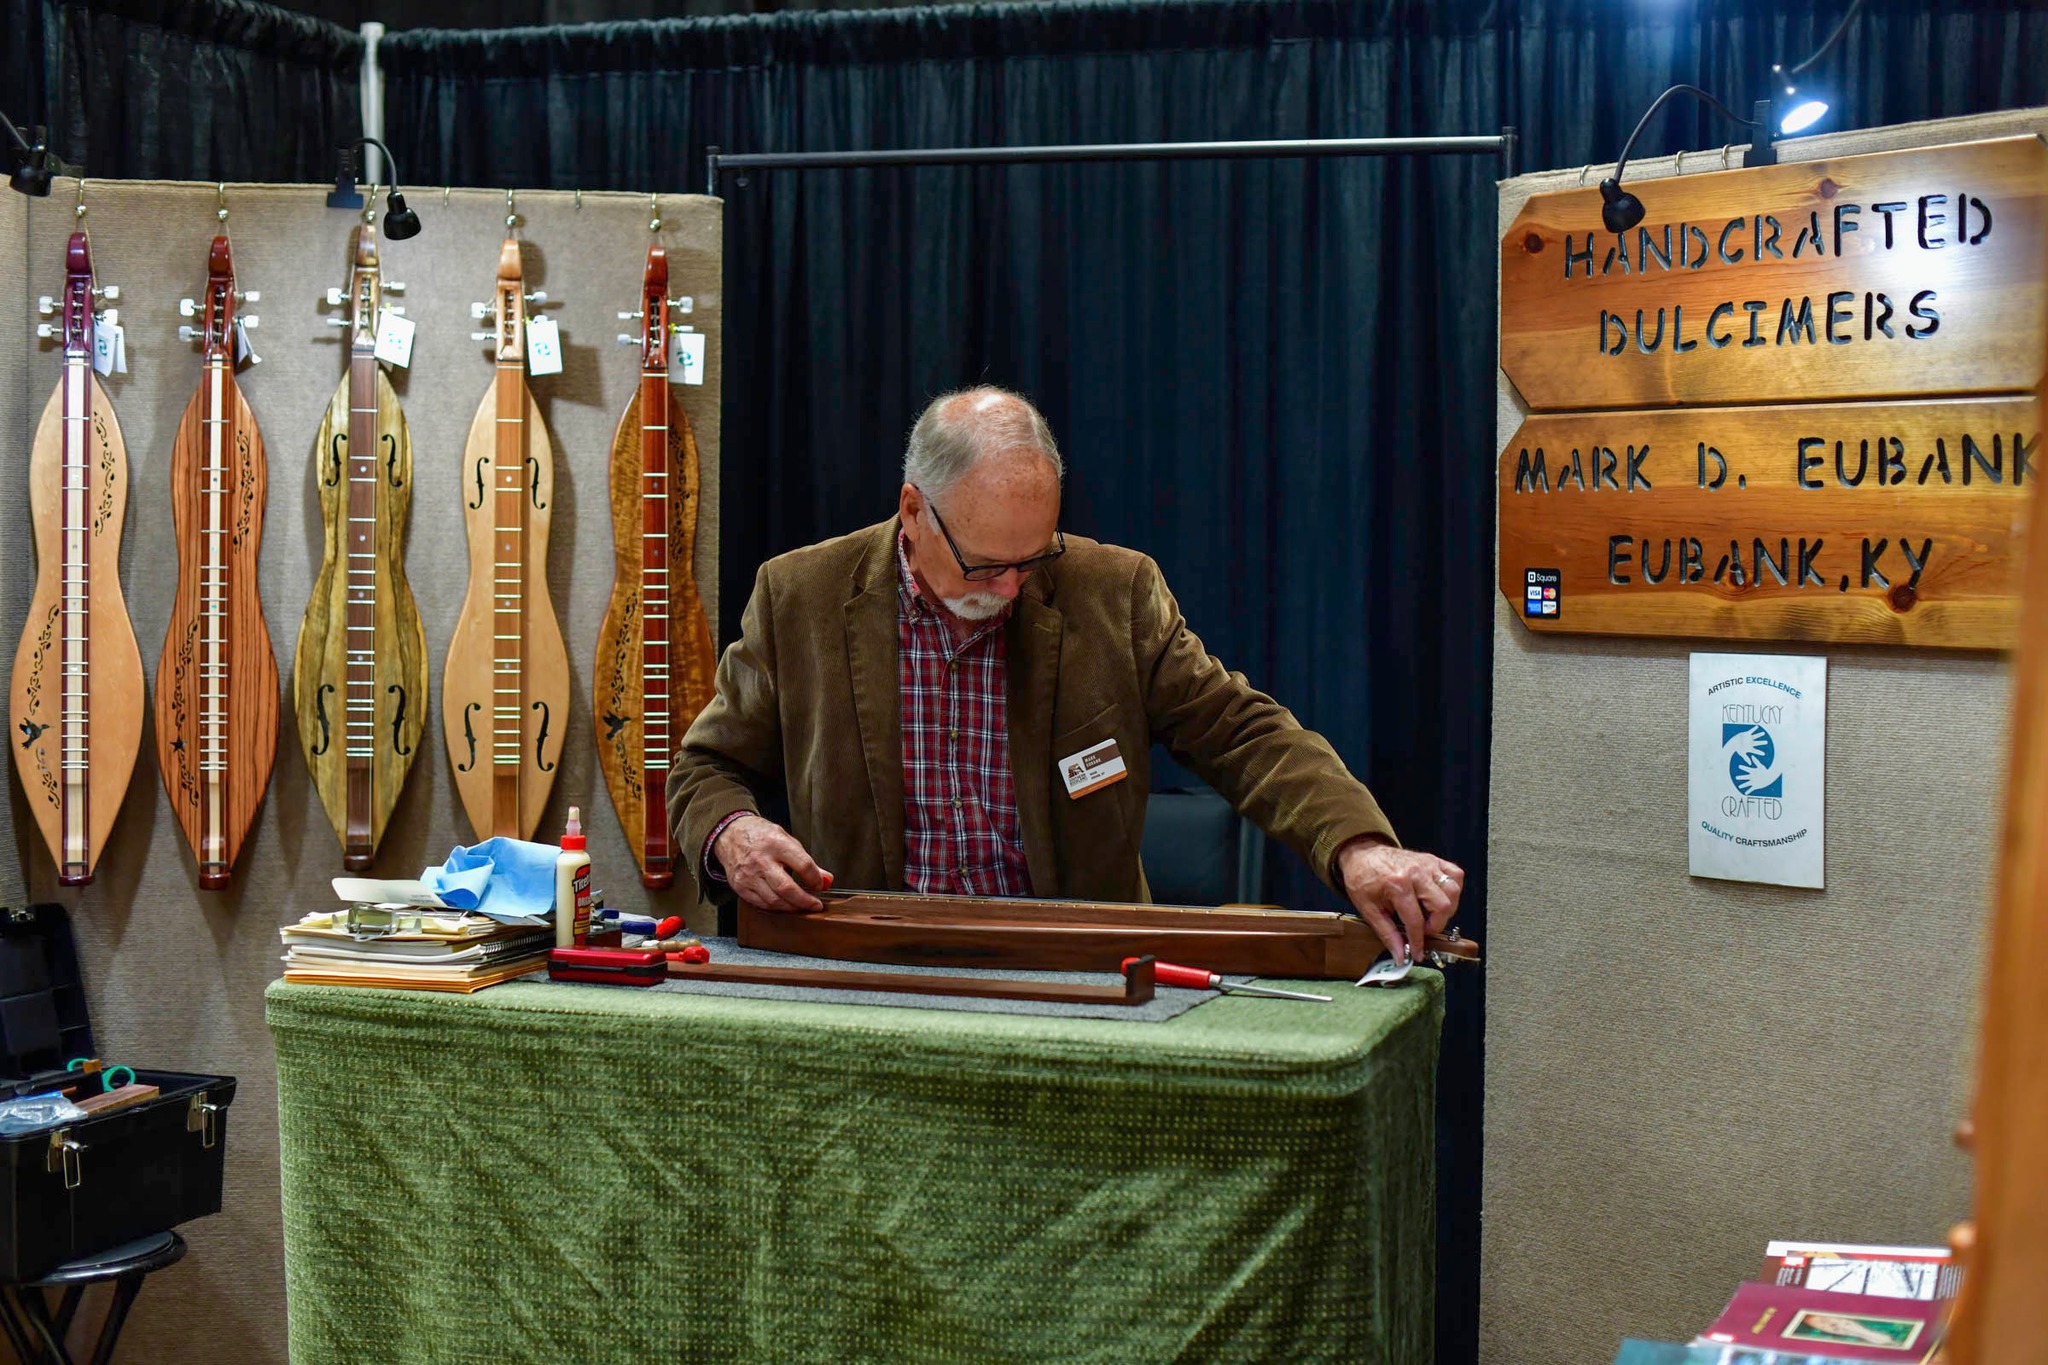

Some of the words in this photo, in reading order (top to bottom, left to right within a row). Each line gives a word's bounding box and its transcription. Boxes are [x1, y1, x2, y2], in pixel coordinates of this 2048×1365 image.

[1565, 193, 1993, 280] HANDCRAFTED
[1600, 289, 1941, 356] DULCIMERS
[1515, 443, 1652, 494] MARK
[1697, 441, 1747, 490] D.
[1798, 432, 2041, 489] EUBANK
[1536, 573, 1557, 583] Square
[1708, 677, 1744, 696] ARTISTIC
[1745, 676, 1802, 699] EXCELLENCE
[1722, 704, 1784, 724] KENTUCKY
[1721, 795, 1783, 821] CRAFTED
[1701, 820, 1734, 842] QUALITY
[1735, 828, 1807, 847] CRAFTSMANSHIP
